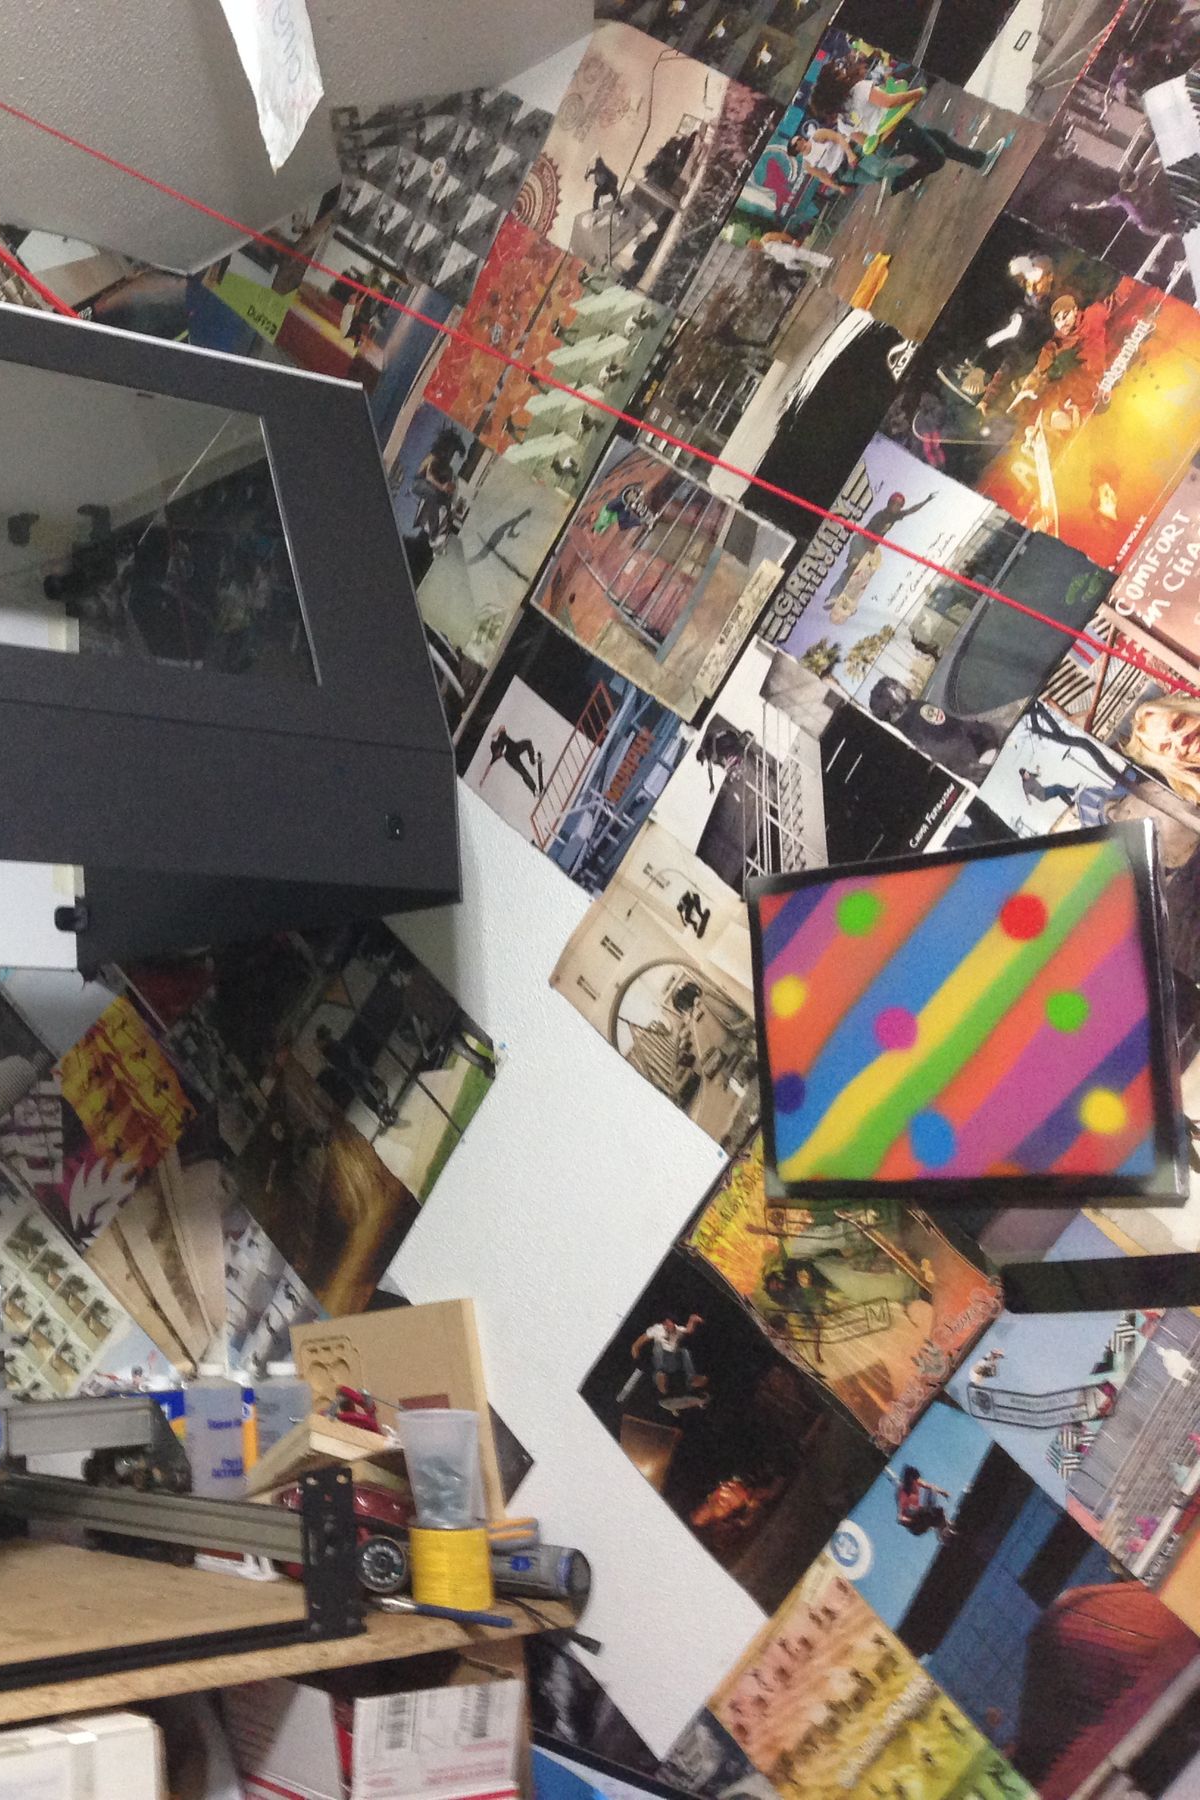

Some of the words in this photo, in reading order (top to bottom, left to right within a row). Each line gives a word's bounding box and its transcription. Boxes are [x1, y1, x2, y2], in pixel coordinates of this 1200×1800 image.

[770, 496, 856, 619] GRAVITY
[785, 506, 864, 625] SKATEBOARDS
[1115, 509, 1191, 617] COMFORT
[1135, 598, 1172, 628] in
